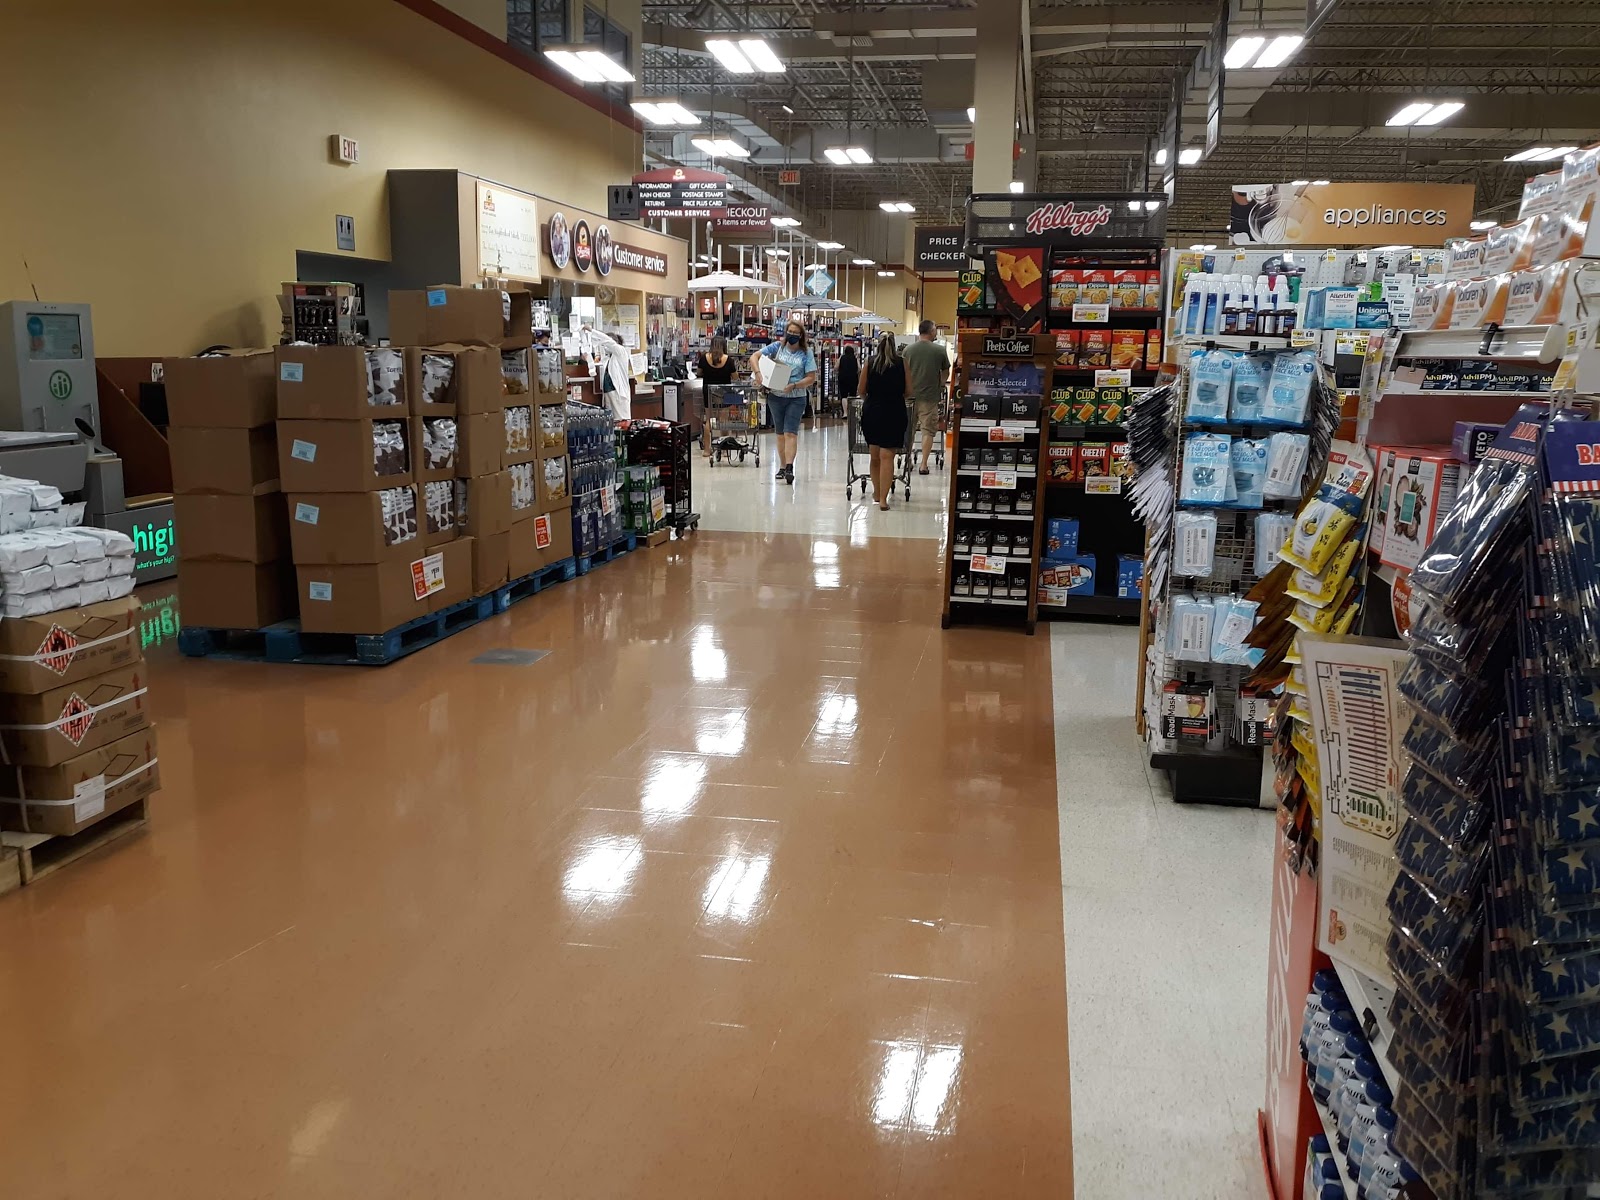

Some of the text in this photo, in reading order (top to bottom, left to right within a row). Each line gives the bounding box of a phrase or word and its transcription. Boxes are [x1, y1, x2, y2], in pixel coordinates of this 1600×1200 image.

[343, 138, 356, 160] EXIT
[783, 171, 797, 182] EXIT
[727, 208, 768, 217] HECKOUT
[1324, 204, 1447, 228] appliances
[1026, 202, 1112, 236] Kellogg's
[614, 244, 665, 272] Customer service
[962, 272, 982, 283] CLUB
[704, 299, 710, 308] 5
[748, 306, 753, 314] 7
[763, 308, 768, 316] 8
[1006, 341, 1029, 353] Coffee
[974, 378, 1027, 387] Hand-Selected
[1051, 390, 1070, 400] CLUB
[1076, 390, 1096, 400] CLUB
[1102, 390, 1122, 400] CLUB
[1475, 432, 1487, 459] KETO
[1332, 454, 1345, 463] NEW
[133, 520, 174, 557] higi
[136, 555, 175, 569] what's your higi?
[111, 710, 127, 720] CHINA
[1167, 695, 1176, 738] ReadiMask
[1248, 700, 1256, 744] ReadiMask
